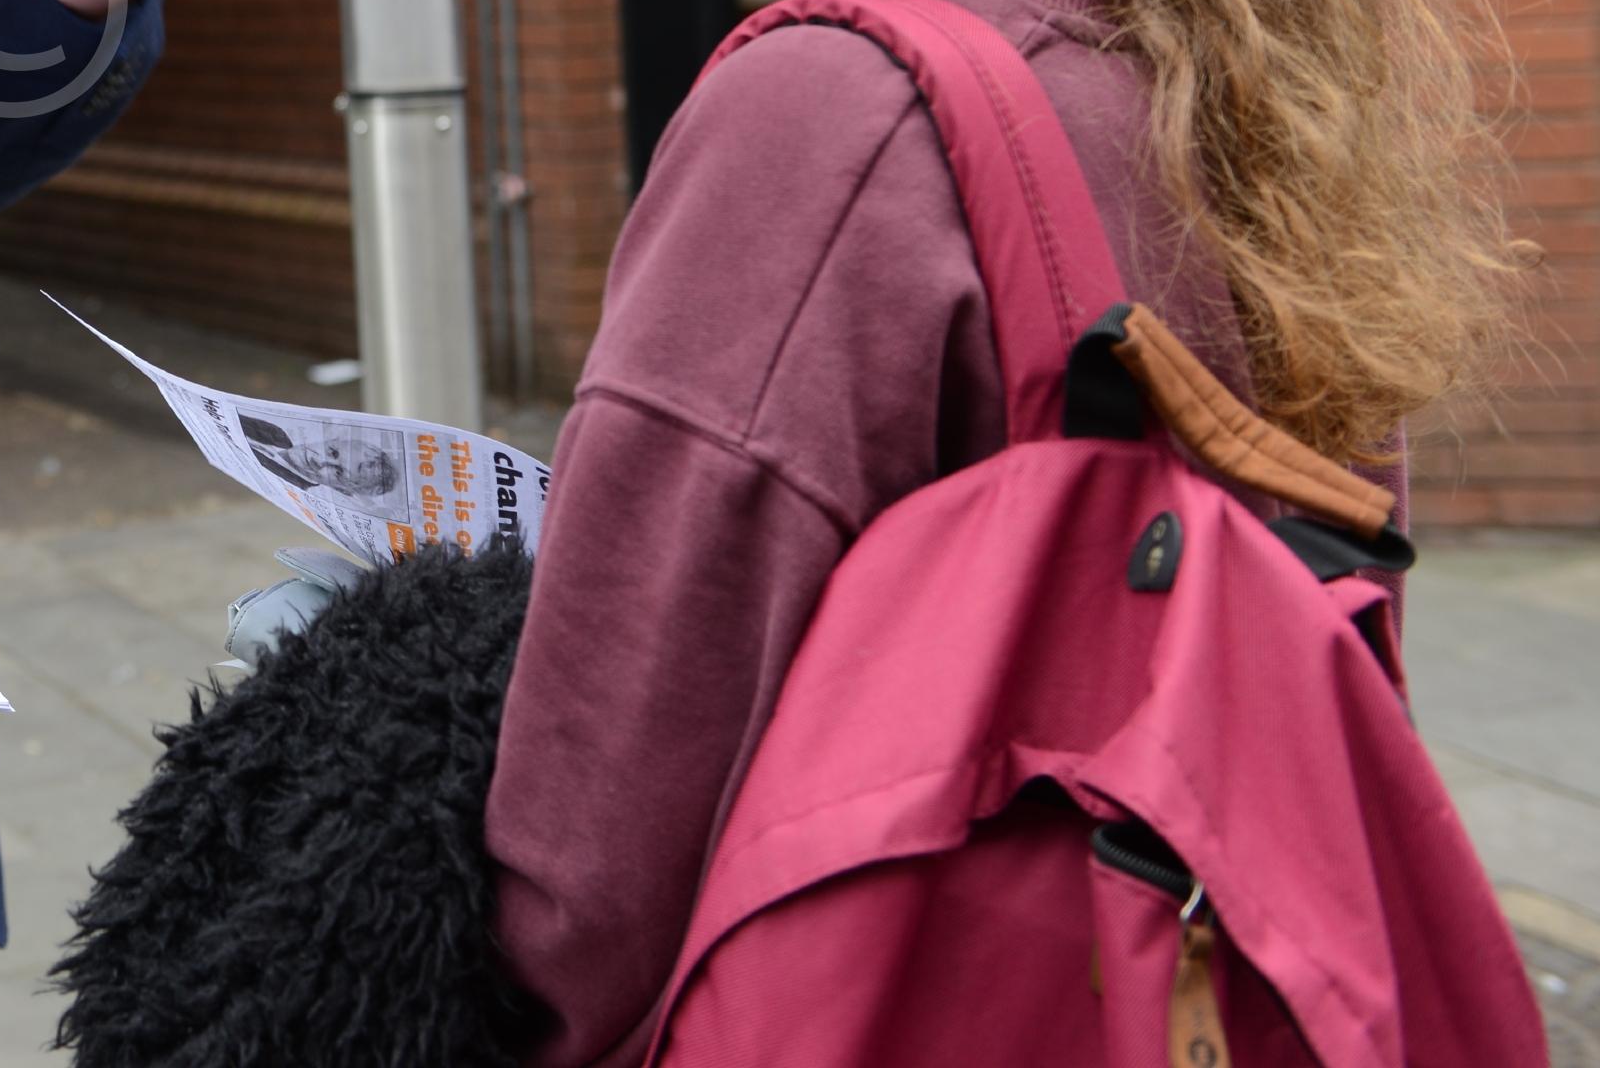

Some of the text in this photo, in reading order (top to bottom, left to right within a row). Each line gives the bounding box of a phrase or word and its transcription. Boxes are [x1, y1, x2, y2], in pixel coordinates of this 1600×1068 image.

[417, 434, 440, 476] the
[450, 441, 474, 492] This
[454, 500, 476, 522] is
[494, 452, 523, 550] chan
